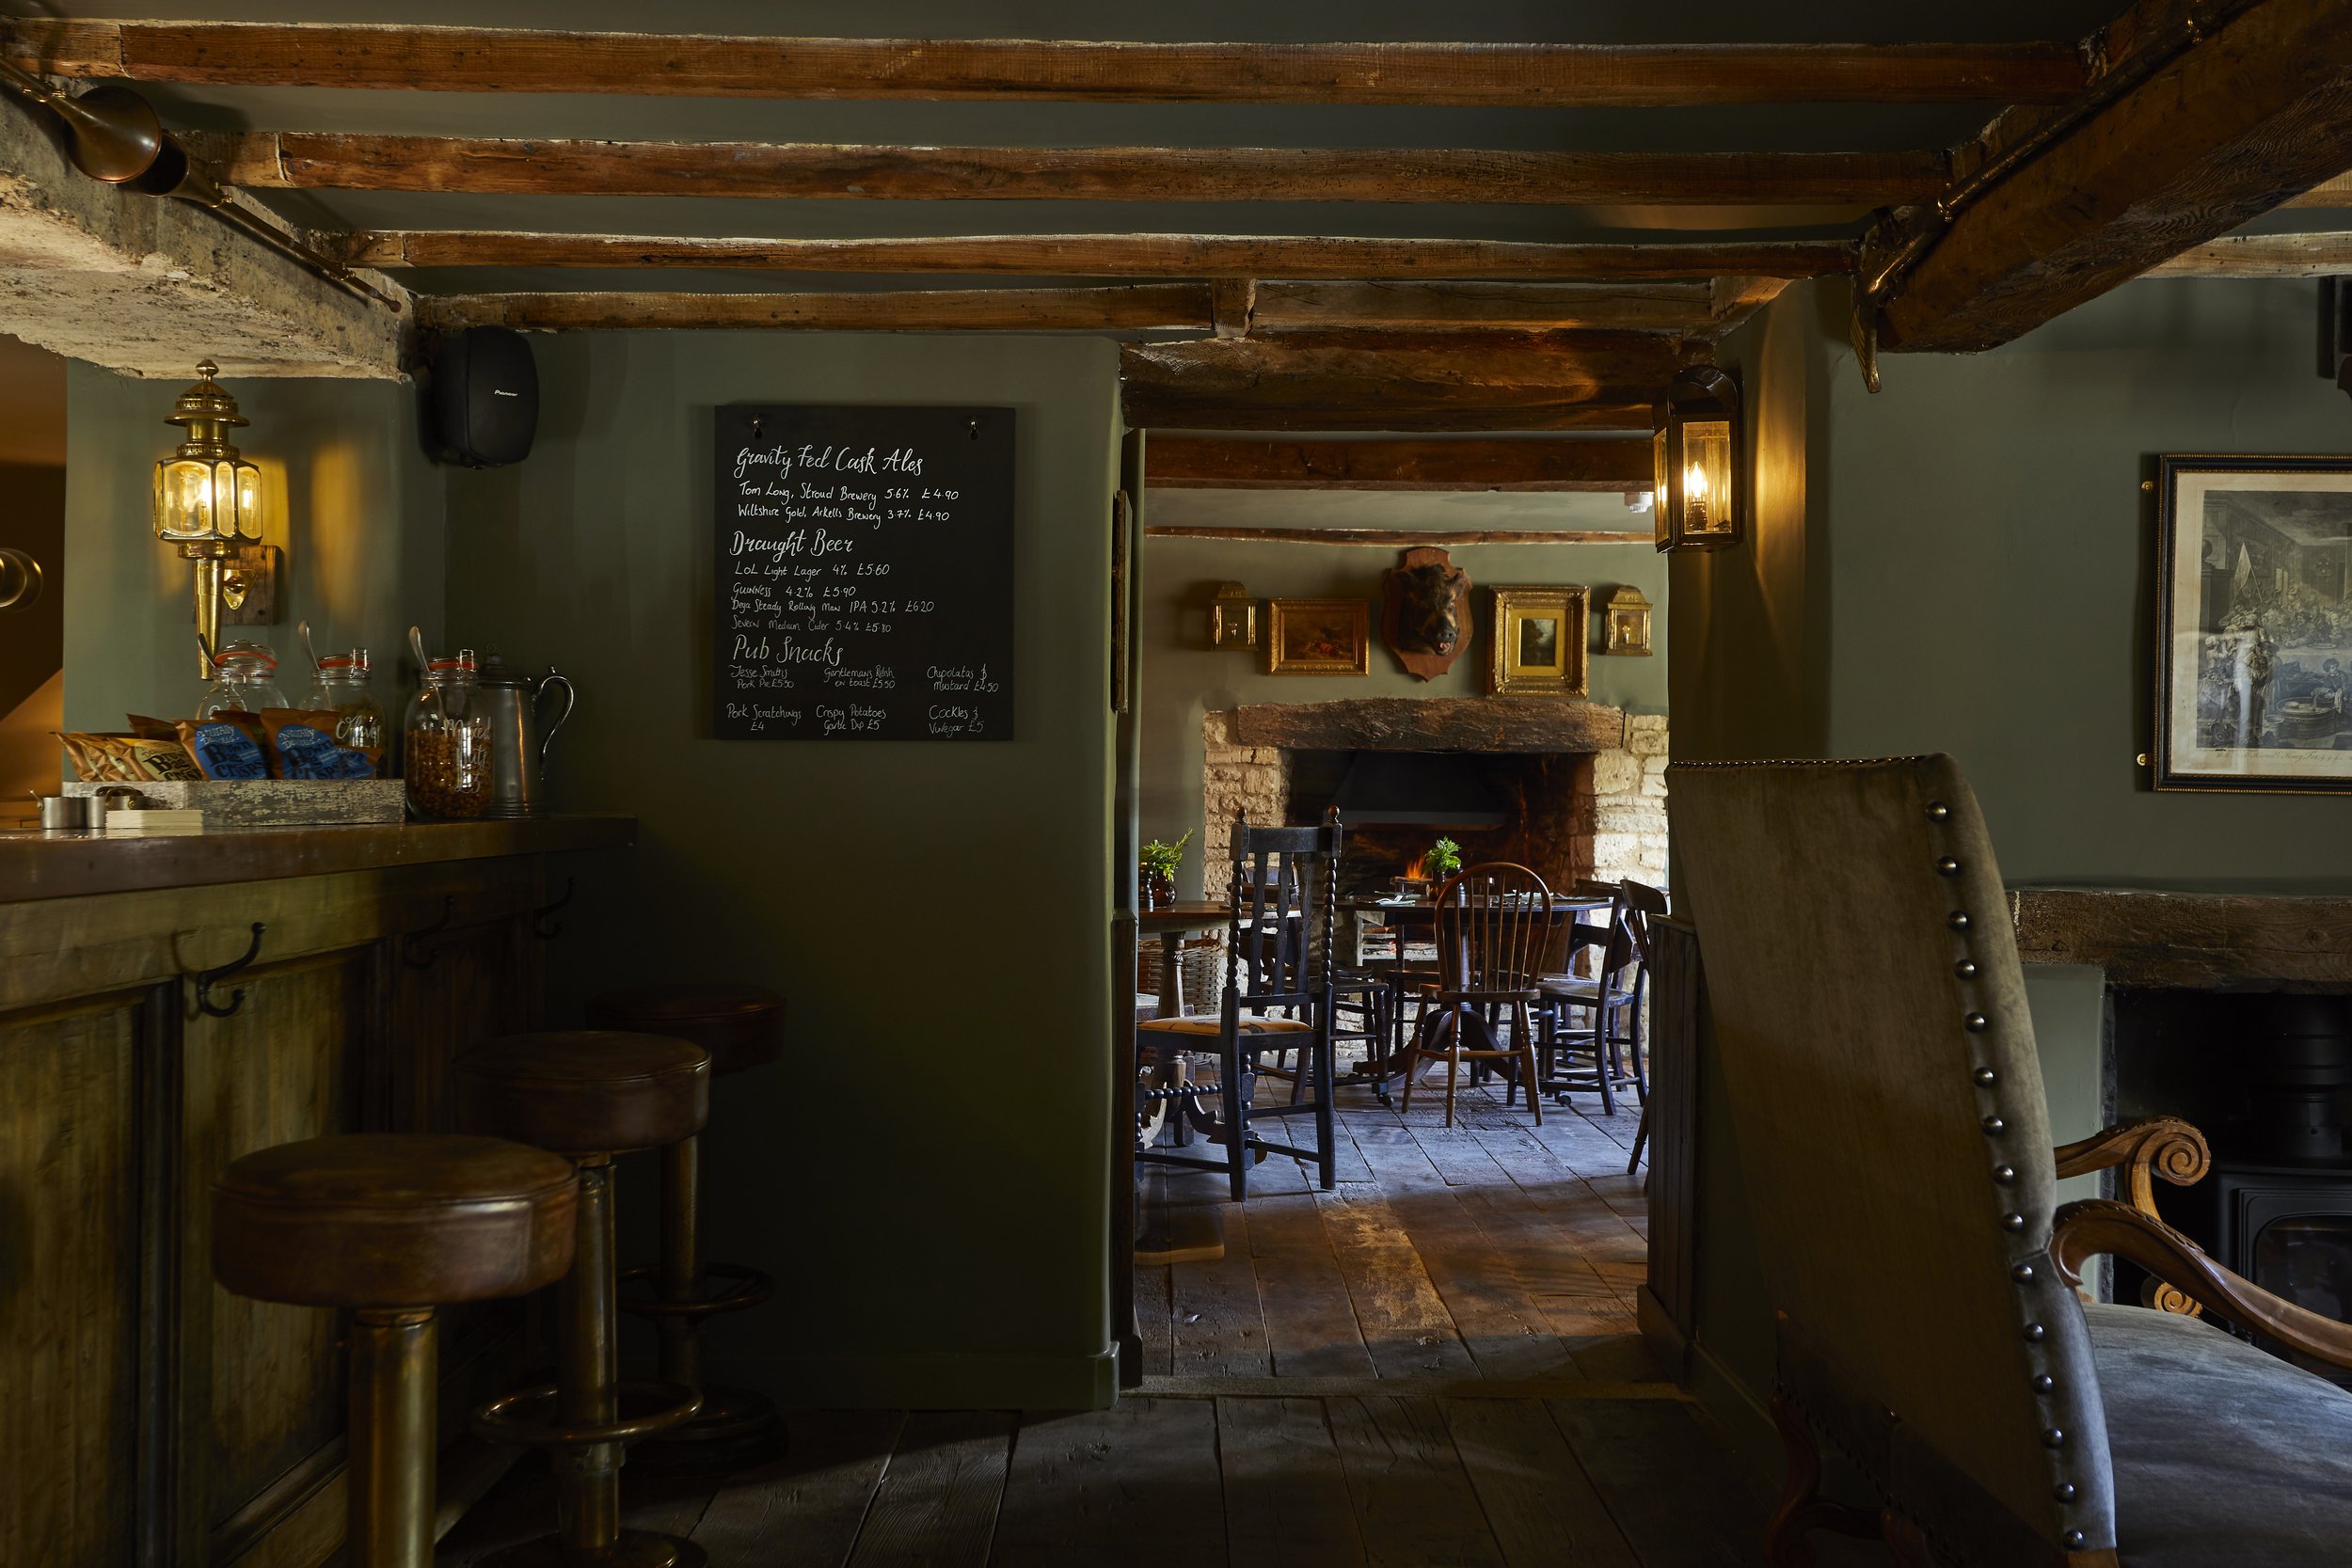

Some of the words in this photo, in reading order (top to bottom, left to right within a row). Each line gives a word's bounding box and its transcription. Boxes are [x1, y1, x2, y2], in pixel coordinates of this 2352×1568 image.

[734, 445, 792, 480] Gravity
[798, 444, 833, 468] Fed
[834, 447, 877, 475] Cask
[882, 448, 924, 476] Ales
[739, 480, 761, 496] Tom
[765, 482, 794, 505] Long,
[799, 482, 834, 499] Stroud
[839, 485, 877, 510] Brewery
[883, 488, 910, 499] 5.6%
[738, 504, 780, 516] Wiltshire
[785, 506, 807, 523] Gold,
[811, 506, 843, 518] Arkells
[846, 507, 882, 530] Brewery
[887, 509, 913, 520] 3.7%
[917, 509, 950, 522] £4.90
[729, 529, 807, 562] Draught
[810, 528, 853, 557] Beer
[763, 564, 788, 581] Light
[793, 565, 822, 582] Lager
[832, 563, 848, 576] 4%
[856, 562, 890, 576] £5.60
[785, 585, 814, 598] 4.2%
[822, 585, 856, 597] £5.90
[731, 598, 752, 614] Deya
[754, 598, 782, 619] Steady
[788, 599, 816, 621] Rolling
[821, 602, 841, 612] Man
[850, 600, 867, 613] IPA
[871, 600, 896, 614] 5.2%
[731, 614, 760, 630] Severn
[768, 619, 802, 631] Medium
[808, 618, 830, 631] Cider
[733, 633, 770, 660] Pub
[776, 636, 844, 667] Snacks
[728, 664, 758, 678] Jesse
[823, 667, 873, 683] Gentlemans
[737, 678, 755, 689] Pork
[849, 677, 870, 688] toast
[933, 679, 971, 691] Mustard
[726, 703, 750, 719] Pork
[816, 705, 845, 723] Crispy
[850, 703, 887, 720] Potatoes
[929, 705, 969, 720] Cockles
[750, 721, 765, 731] £4
[850, 718, 865, 731] Dip
[866, 718, 882, 731] £5
[968, 720, 985, 733] £5
